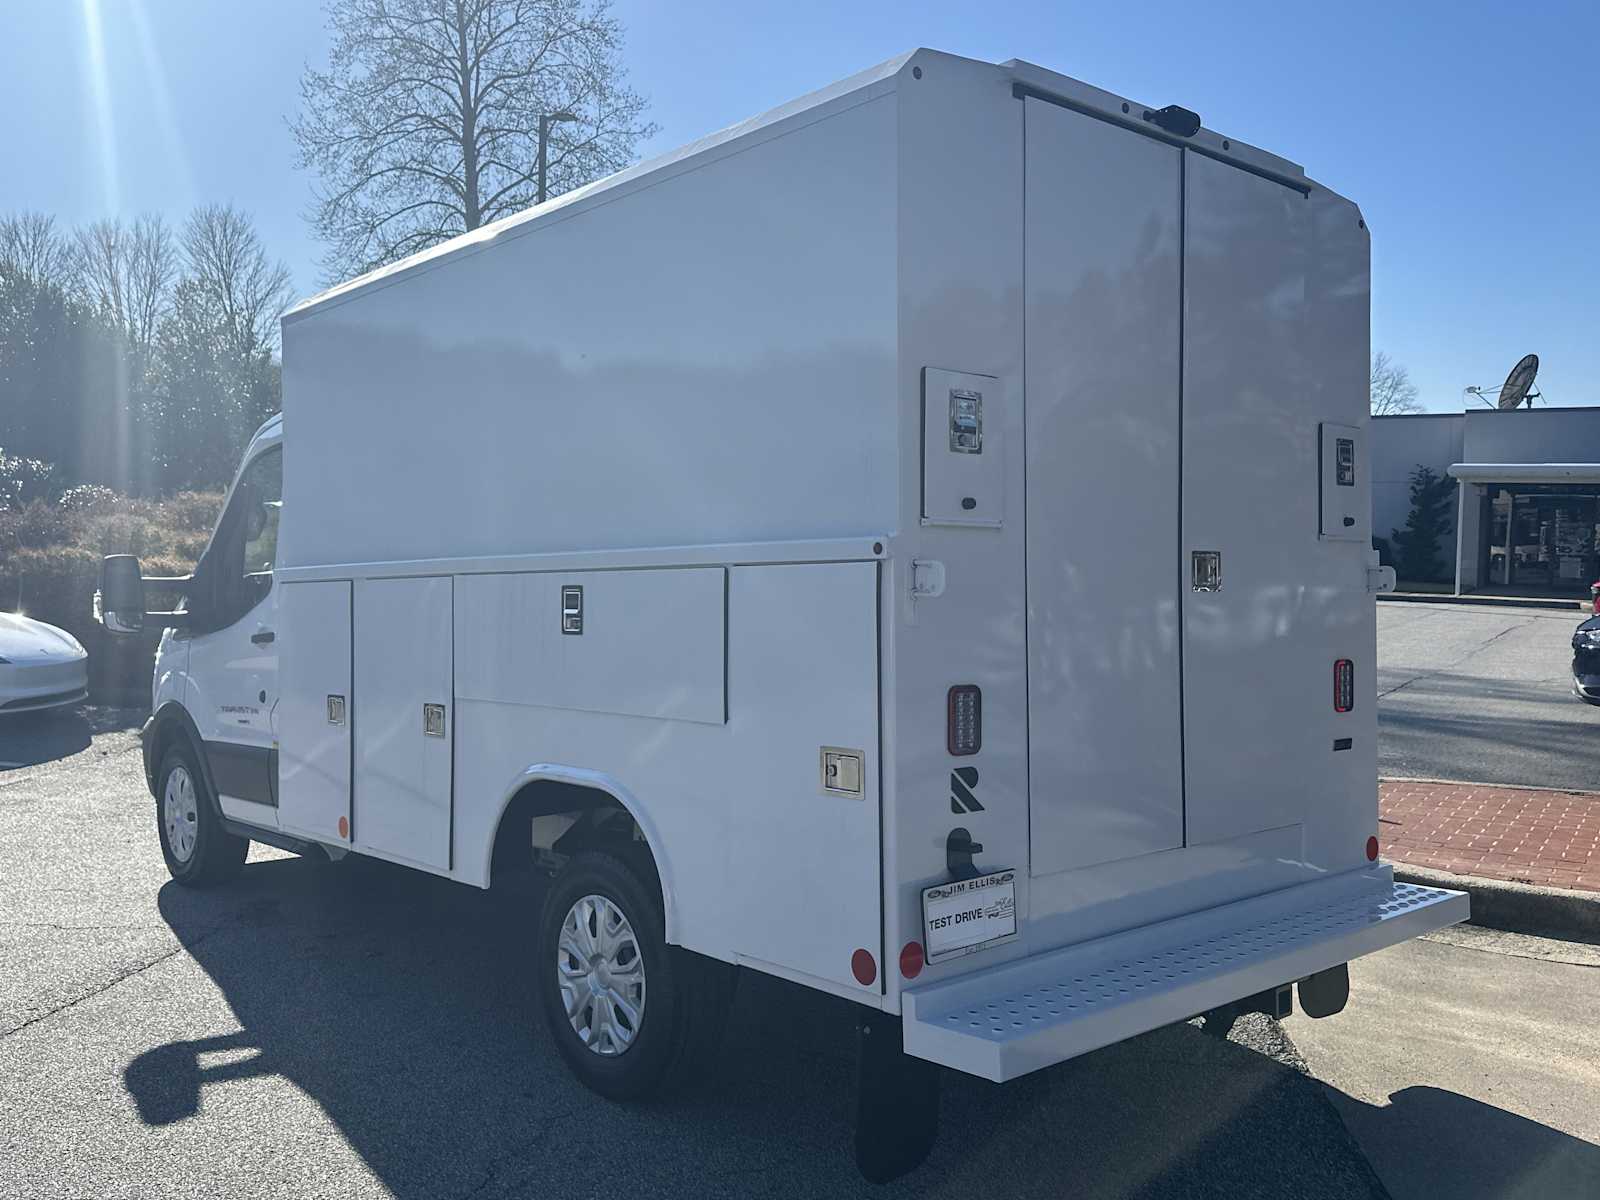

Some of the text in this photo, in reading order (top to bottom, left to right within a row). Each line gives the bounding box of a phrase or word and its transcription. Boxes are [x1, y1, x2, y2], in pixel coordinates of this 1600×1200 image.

[949, 884, 965, 895] JIM
[969, 877, 996, 890] ELLIS
[929, 908, 983, 931] TEST DRIVE
